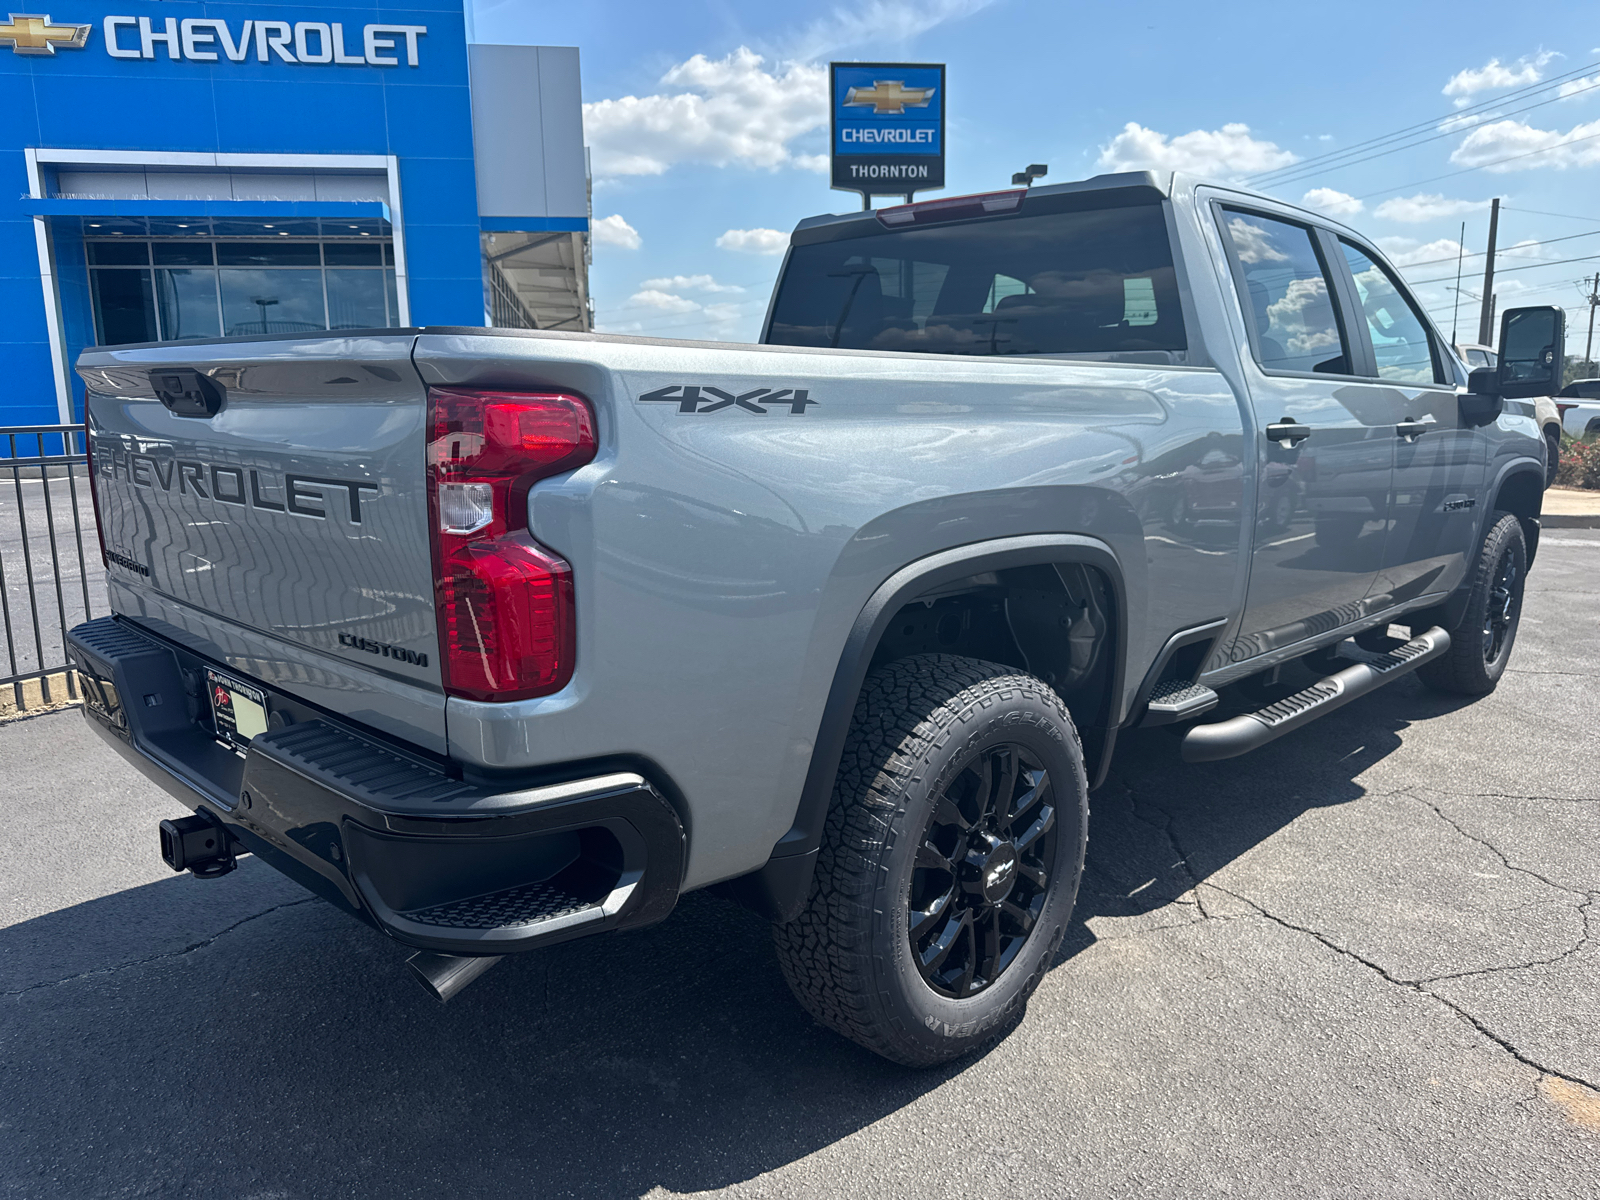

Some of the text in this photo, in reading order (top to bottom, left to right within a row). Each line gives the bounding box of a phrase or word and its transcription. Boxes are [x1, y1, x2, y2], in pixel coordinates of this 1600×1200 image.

[103, 15, 428, 67] CHEVROLET
[842, 128, 936, 143] CHEVROLET
[850, 164, 928, 178] THORNTON
[97, 445, 379, 525] CHEVROLET
[338, 631, 429, 668] CUSTOM
